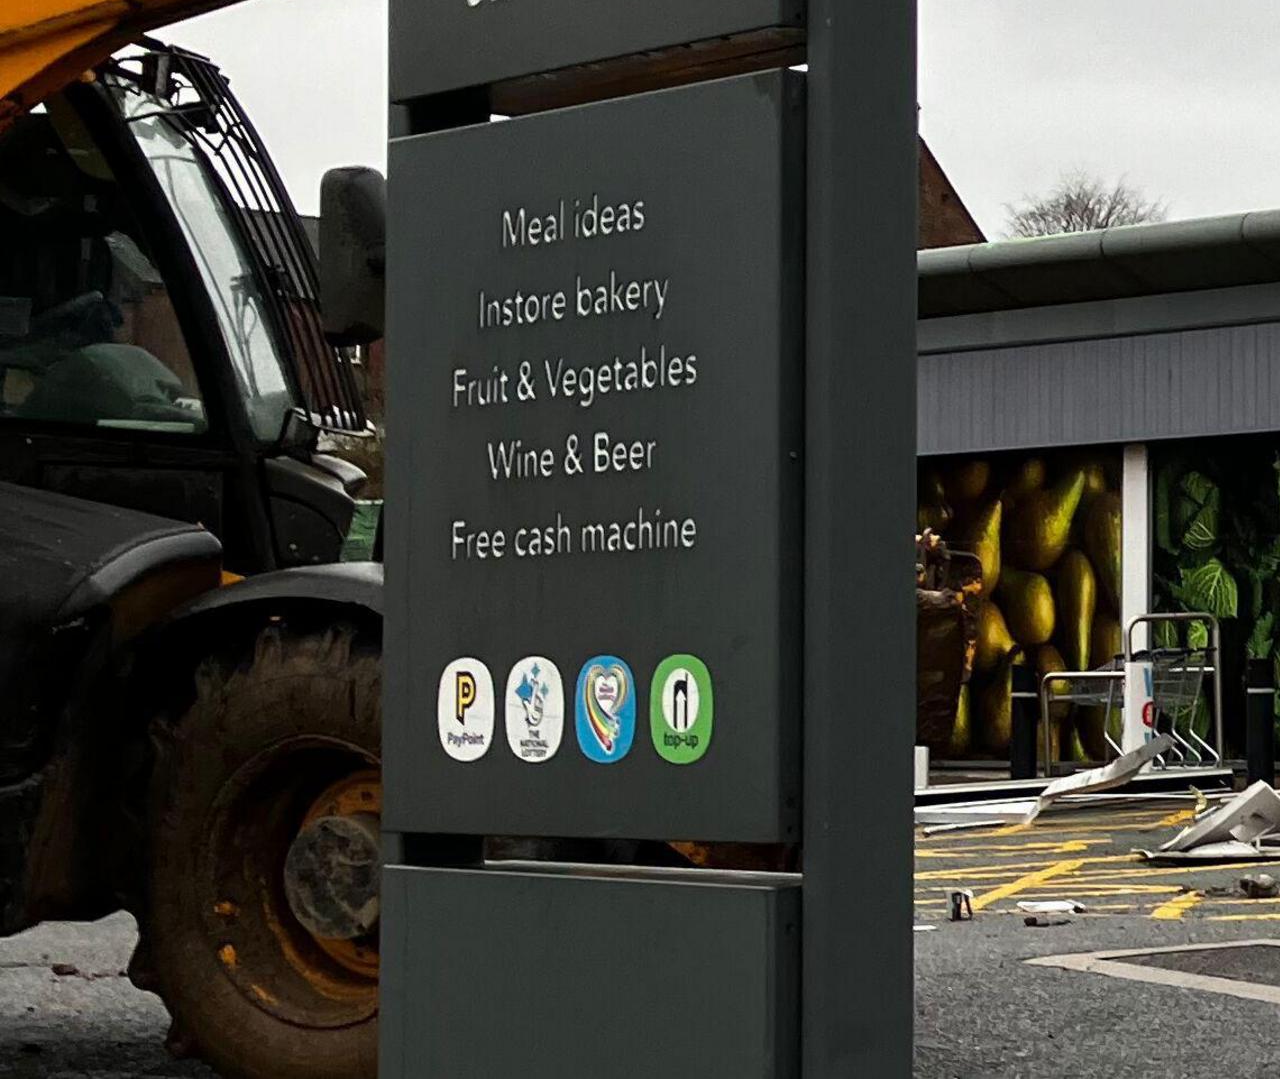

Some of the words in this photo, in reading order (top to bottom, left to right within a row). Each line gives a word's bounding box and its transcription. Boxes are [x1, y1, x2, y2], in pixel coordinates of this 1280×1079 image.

[502, 200, 565, 248] Meal
[574, 195, 645, 239] ideas
[479, 291, 567, 328] Instore
[576, 270, 669, 320] bakery
[453, 365, 509, 407] Fruit
[516, 360, 536, 401] &
[544, 344, 697, 408] Vegetables
[487, 440, 555, 480] Wine
[564, 433, 584, 476] &
[593, 431, 657, 473] Beer
[452, 520, 506, 560] Free
[514, 512, 571, 557] cash
[581, 507, 697, 553] machine
[447, 731, 485, 748] PayPoint
[663, 732, 699, 750] top-up
